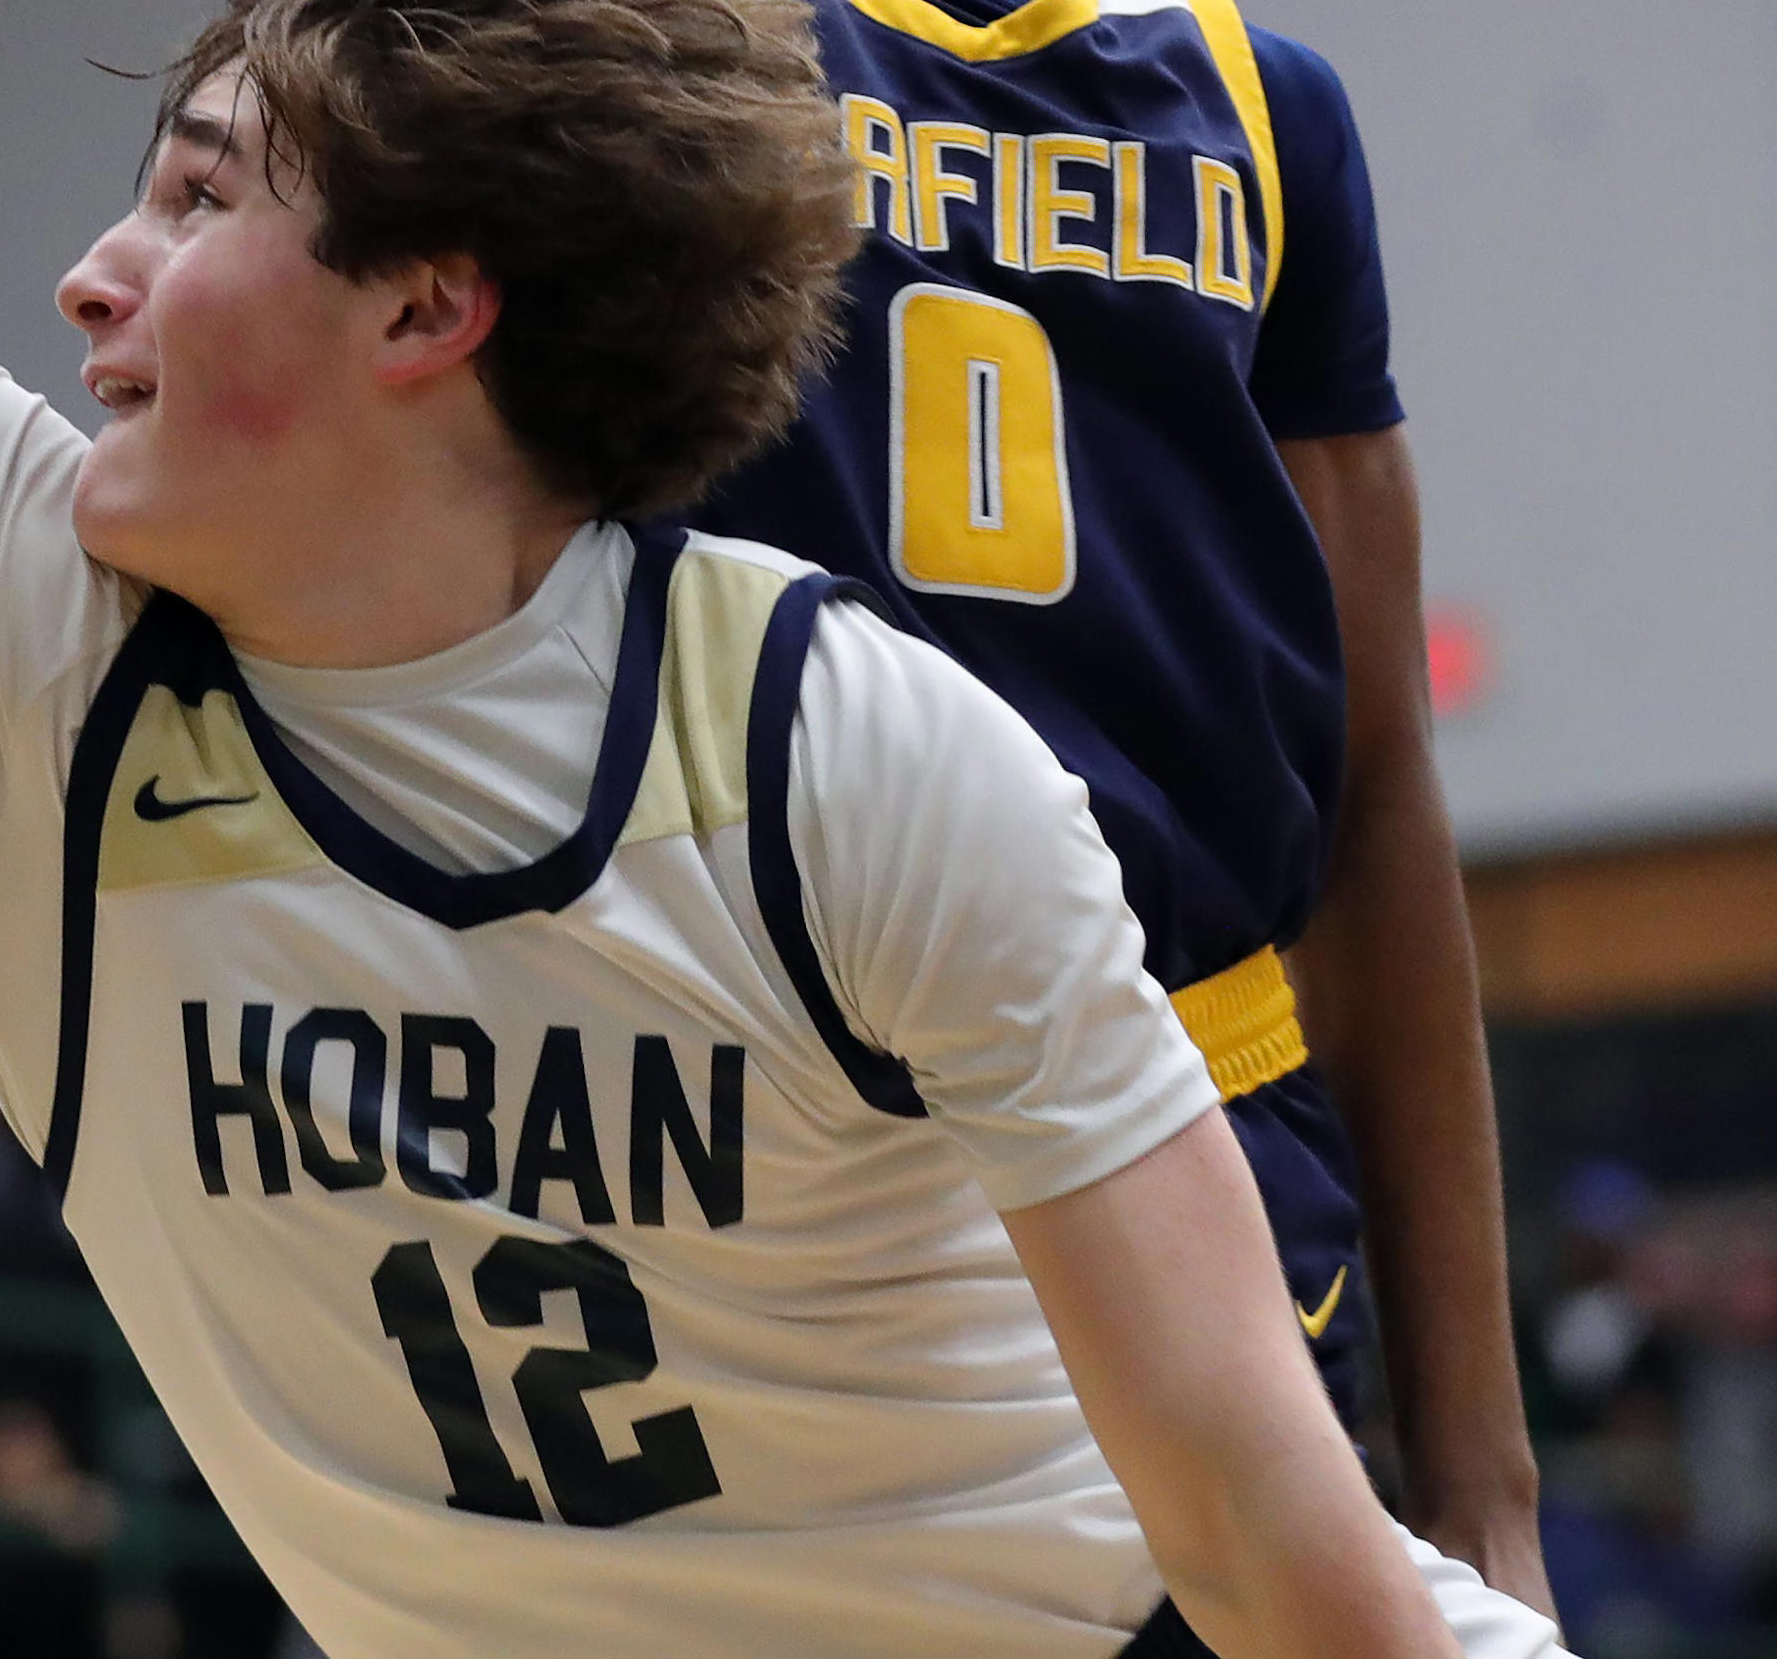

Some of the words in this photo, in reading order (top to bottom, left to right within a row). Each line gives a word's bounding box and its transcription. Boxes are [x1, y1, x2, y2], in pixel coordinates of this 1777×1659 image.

[839, 92, 1254, 312] RFIELD
[888, 282, 1077, 606] 0
[181, 1000, 745, 1230] HOBAN
[371, 1235, 724, 1528] 12
